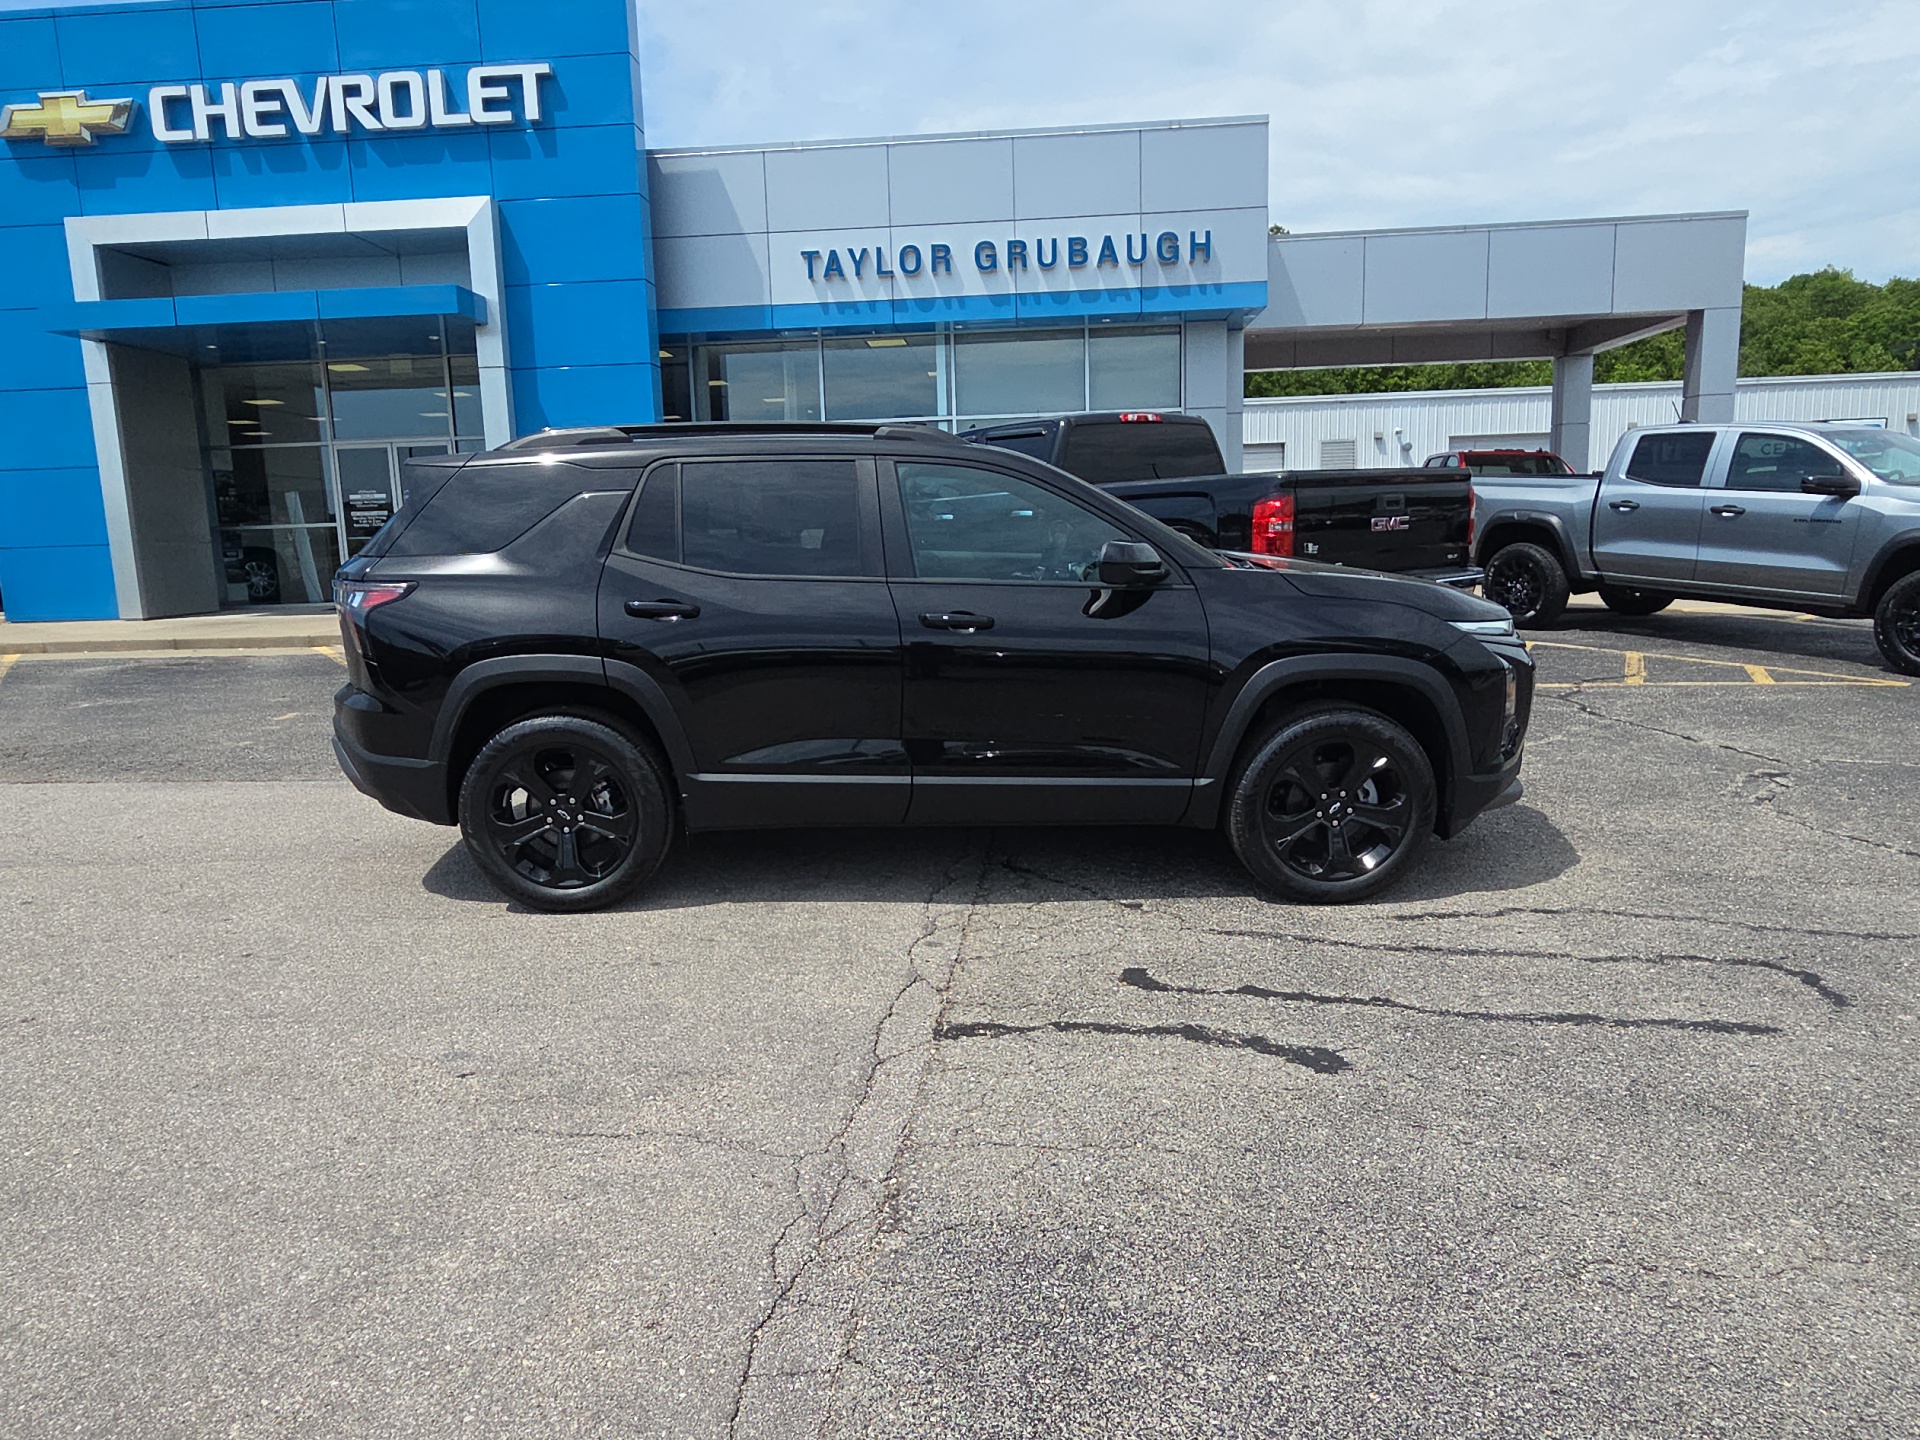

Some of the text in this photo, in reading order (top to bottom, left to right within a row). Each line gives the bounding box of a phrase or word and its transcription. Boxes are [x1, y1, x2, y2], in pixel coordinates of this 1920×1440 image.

[148, 63, 551, 142] CHEVROLET
[800, 230, 1212, 280] TAYLOR GRUBAUGH
[1371, 515, 1410, 532] GMC
